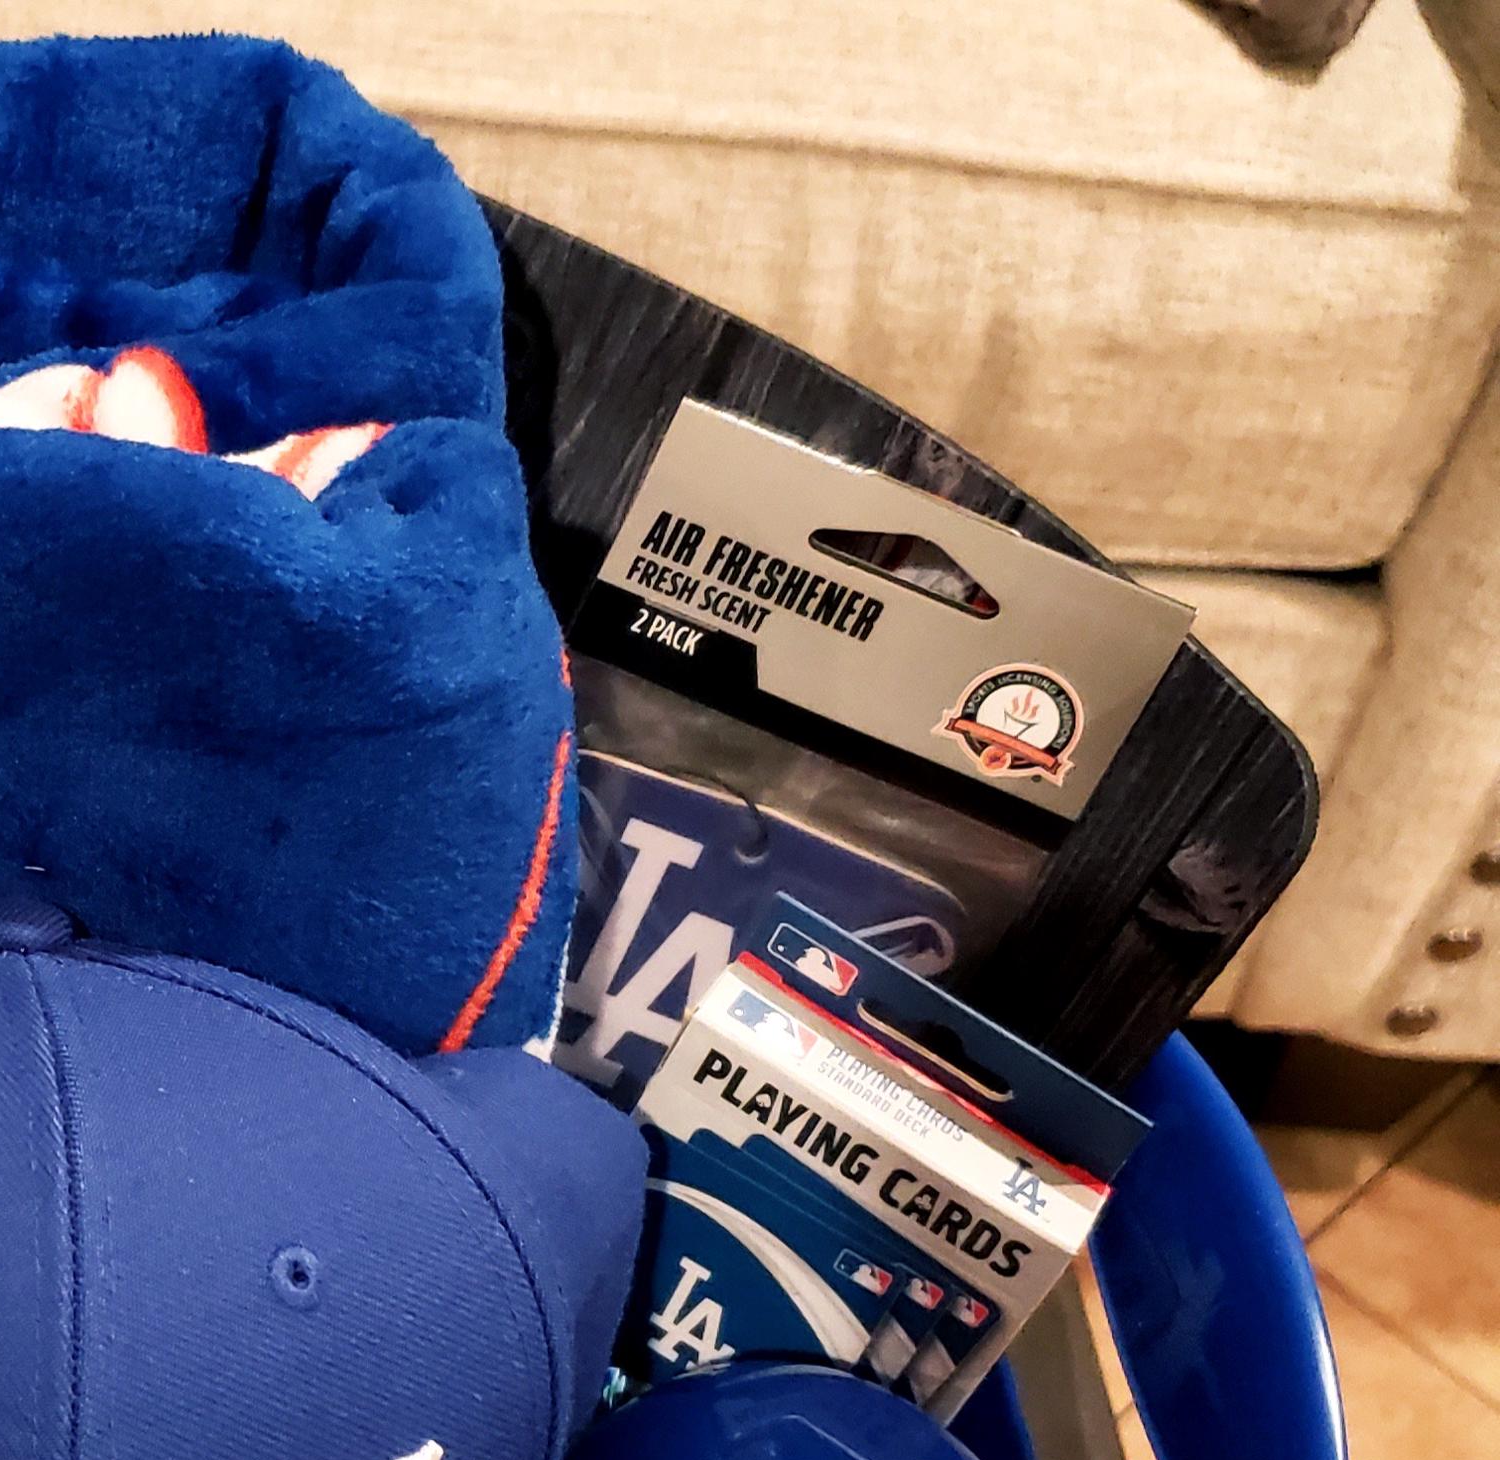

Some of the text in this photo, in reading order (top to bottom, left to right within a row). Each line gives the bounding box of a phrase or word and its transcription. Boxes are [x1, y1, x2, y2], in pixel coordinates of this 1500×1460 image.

[626, 556, 772, 634] FRESH SCENT
[640, 511, 885, 642] AIR FRESHENER
[629, 608, 704, 656] 2 PACK
[551, 817, 735, 1088] LA
[817, 1060, 932, 1140] STANDARD DECK
[826, 1045, 968, 1143] PLAYING CARDS
[693, 1048, 1034, 1280] PLAYING CARDS
[1003, 1156, 1047, 1217] LA
[647, 1256, 736, 1371] LA
